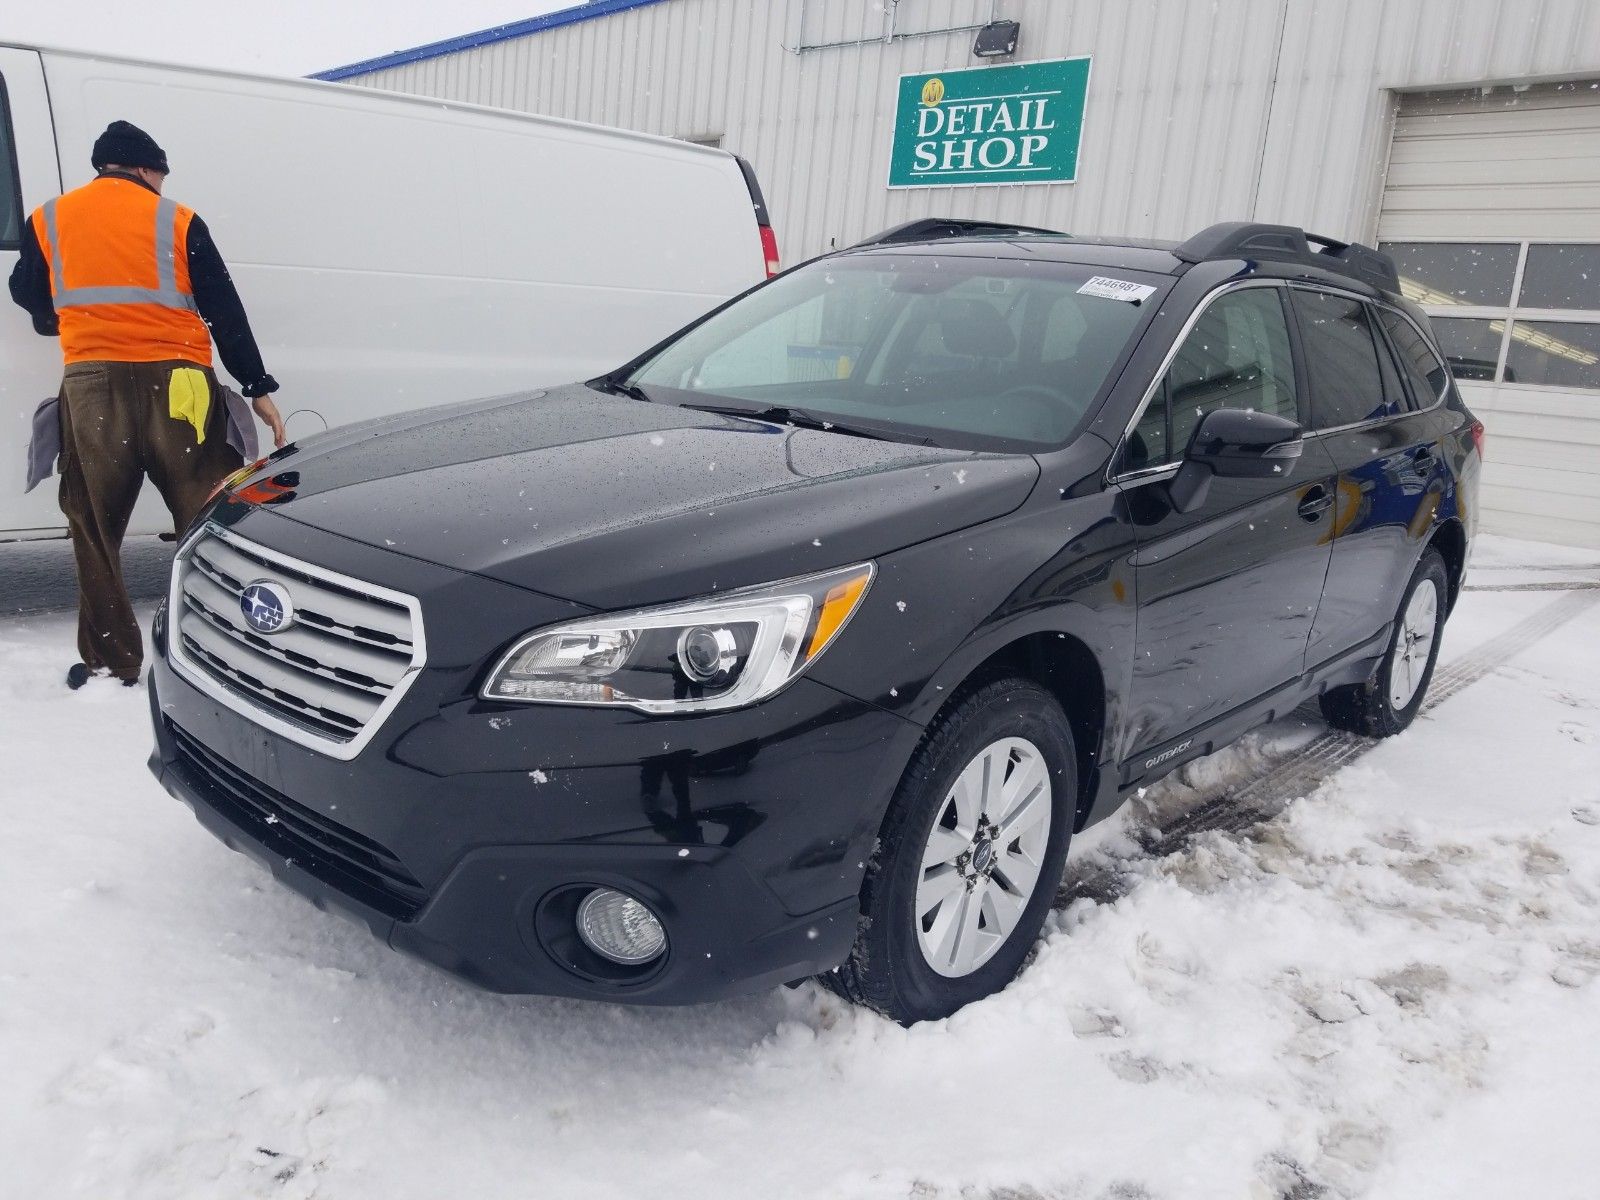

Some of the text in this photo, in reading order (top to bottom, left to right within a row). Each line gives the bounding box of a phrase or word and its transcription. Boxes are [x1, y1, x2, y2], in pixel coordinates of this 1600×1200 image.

[917, 99, 1055, 137] DETAIL
[913, 136, 1049, 171] SHOP
[1089, 277, 1142, 292] 7446987
[1145, 739, 1192, 769] OUTBACK
